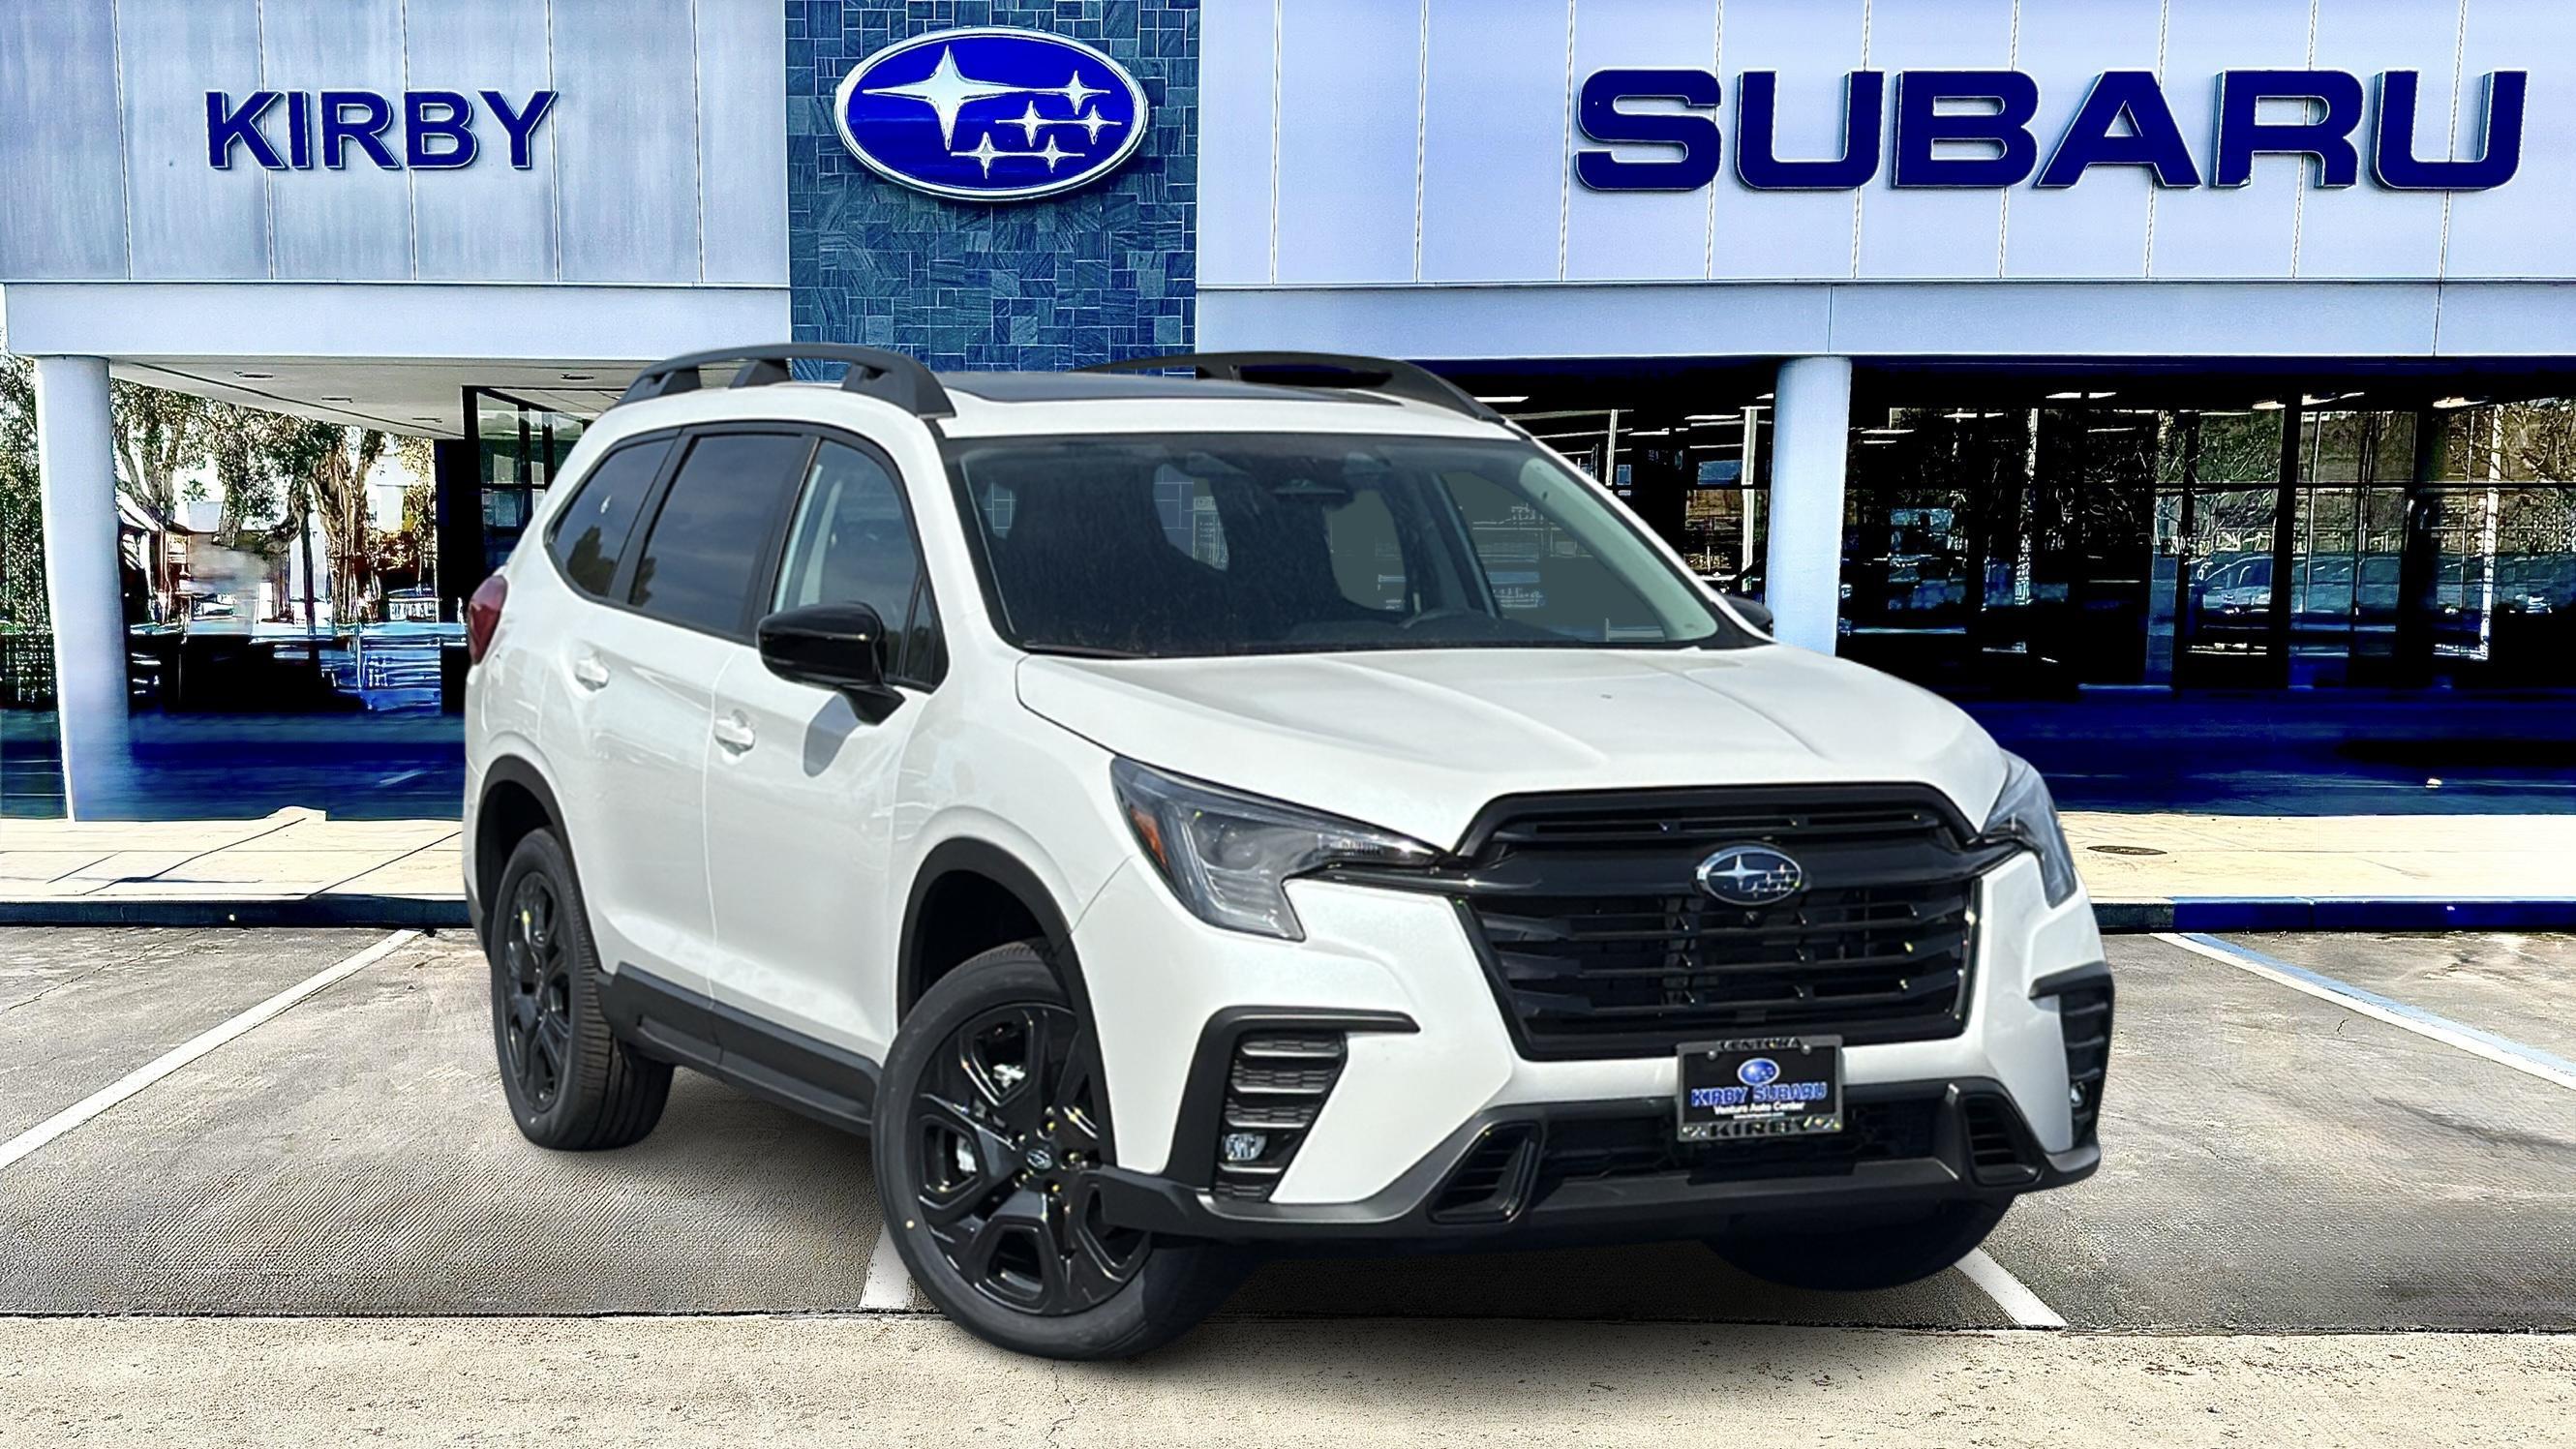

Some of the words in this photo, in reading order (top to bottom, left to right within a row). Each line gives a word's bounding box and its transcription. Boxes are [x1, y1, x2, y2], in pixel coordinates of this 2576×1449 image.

[205, 90, 559, 169] KIRBY
[1575, 69, 2528, 191] SUBARU
[1691, 1086, 1748, 1107] KIRBY
[1753, 1082, 1828, 1102] SUBARU
[1749, 1102, 1773, 1111] Auto
[1773, 1101, 1806, 1110] Center
[1709, 1118, 1812, 1137] KIRBY
